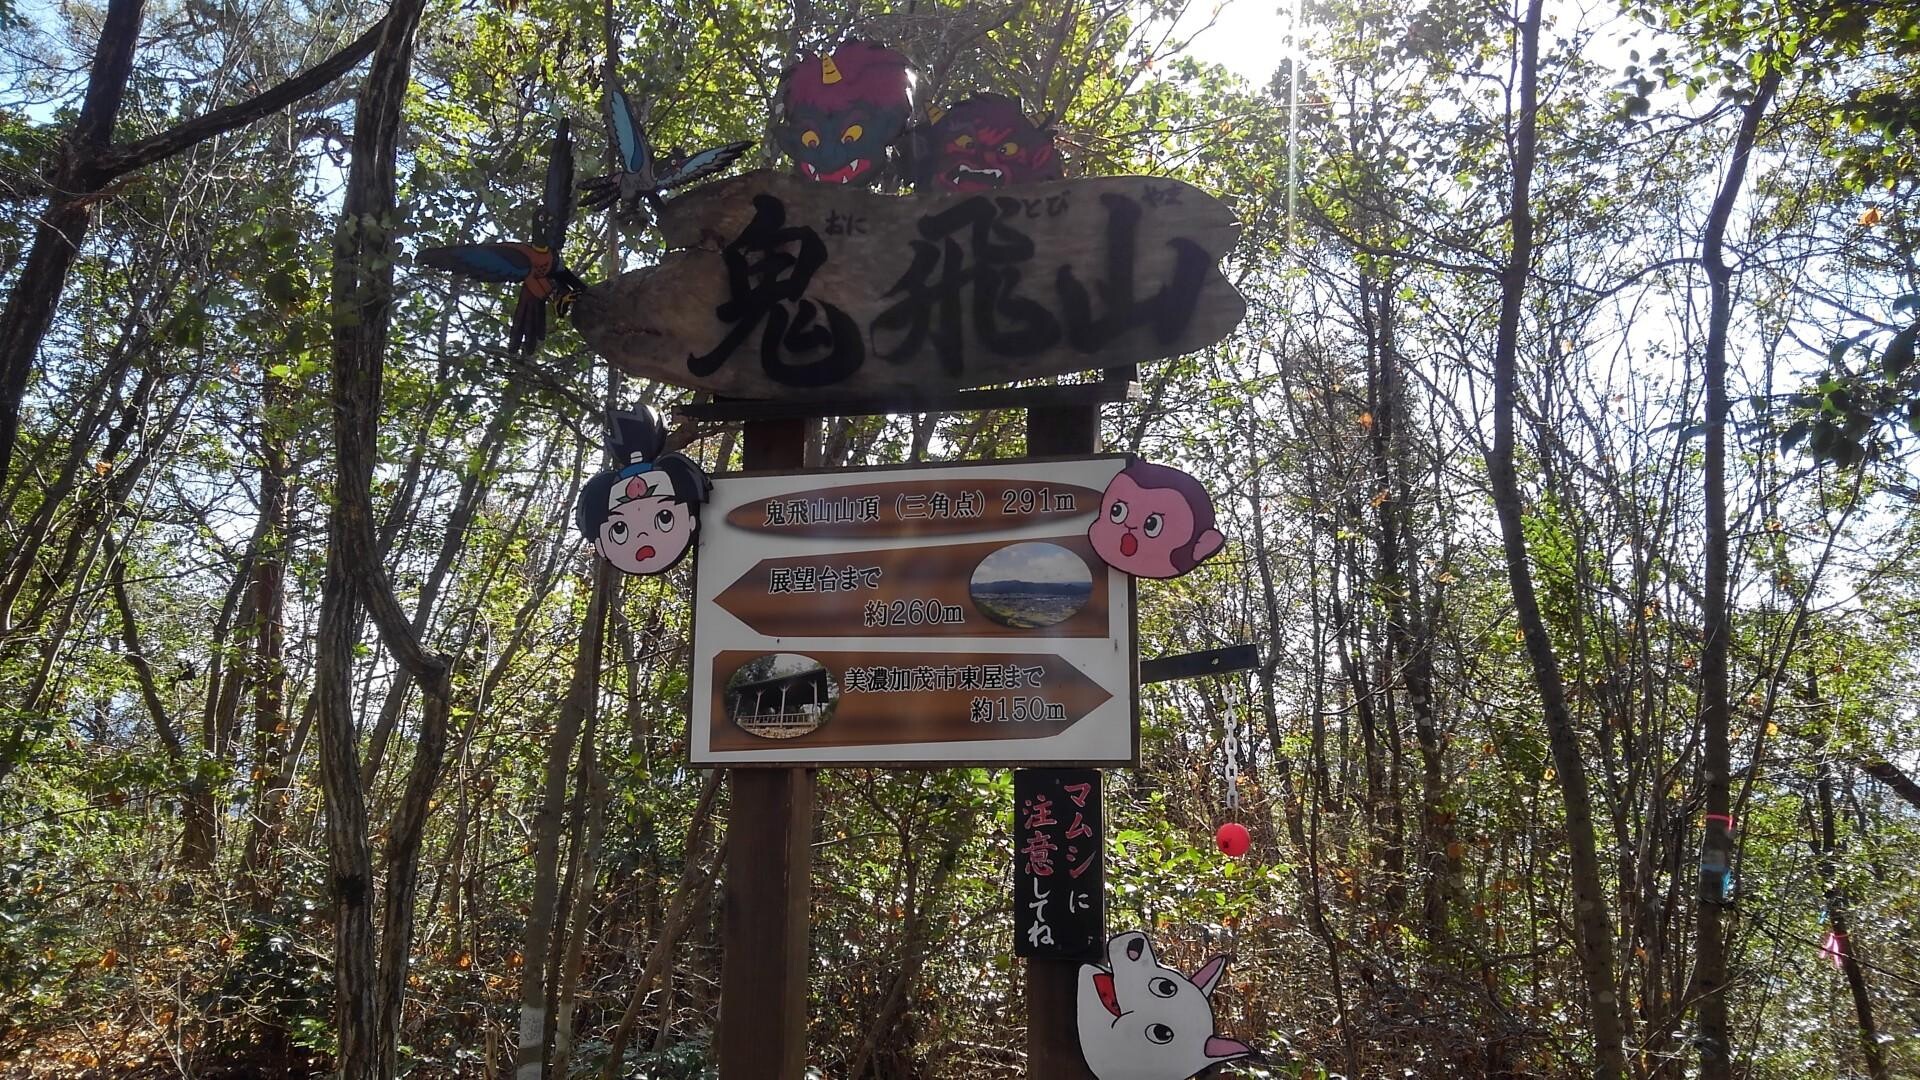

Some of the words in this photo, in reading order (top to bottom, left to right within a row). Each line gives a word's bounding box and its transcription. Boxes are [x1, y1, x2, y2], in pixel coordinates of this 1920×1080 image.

[1023, 188, 1071, 219] とび
[824, 207, 868, 237] おに
[687, 191, 1211, 387] 鬼飛山
[768, 565, 882, 595] 展望台まで
[863, 599, 964, 627] 約260m
[843, 663, 1044, 694] 美濃加茂市東屋まで
[970, 696, 1067, 723] 約150m
[1063, 782, 1097, 915] マムシに
[1020, 793, 1059, 948] 注意してね
